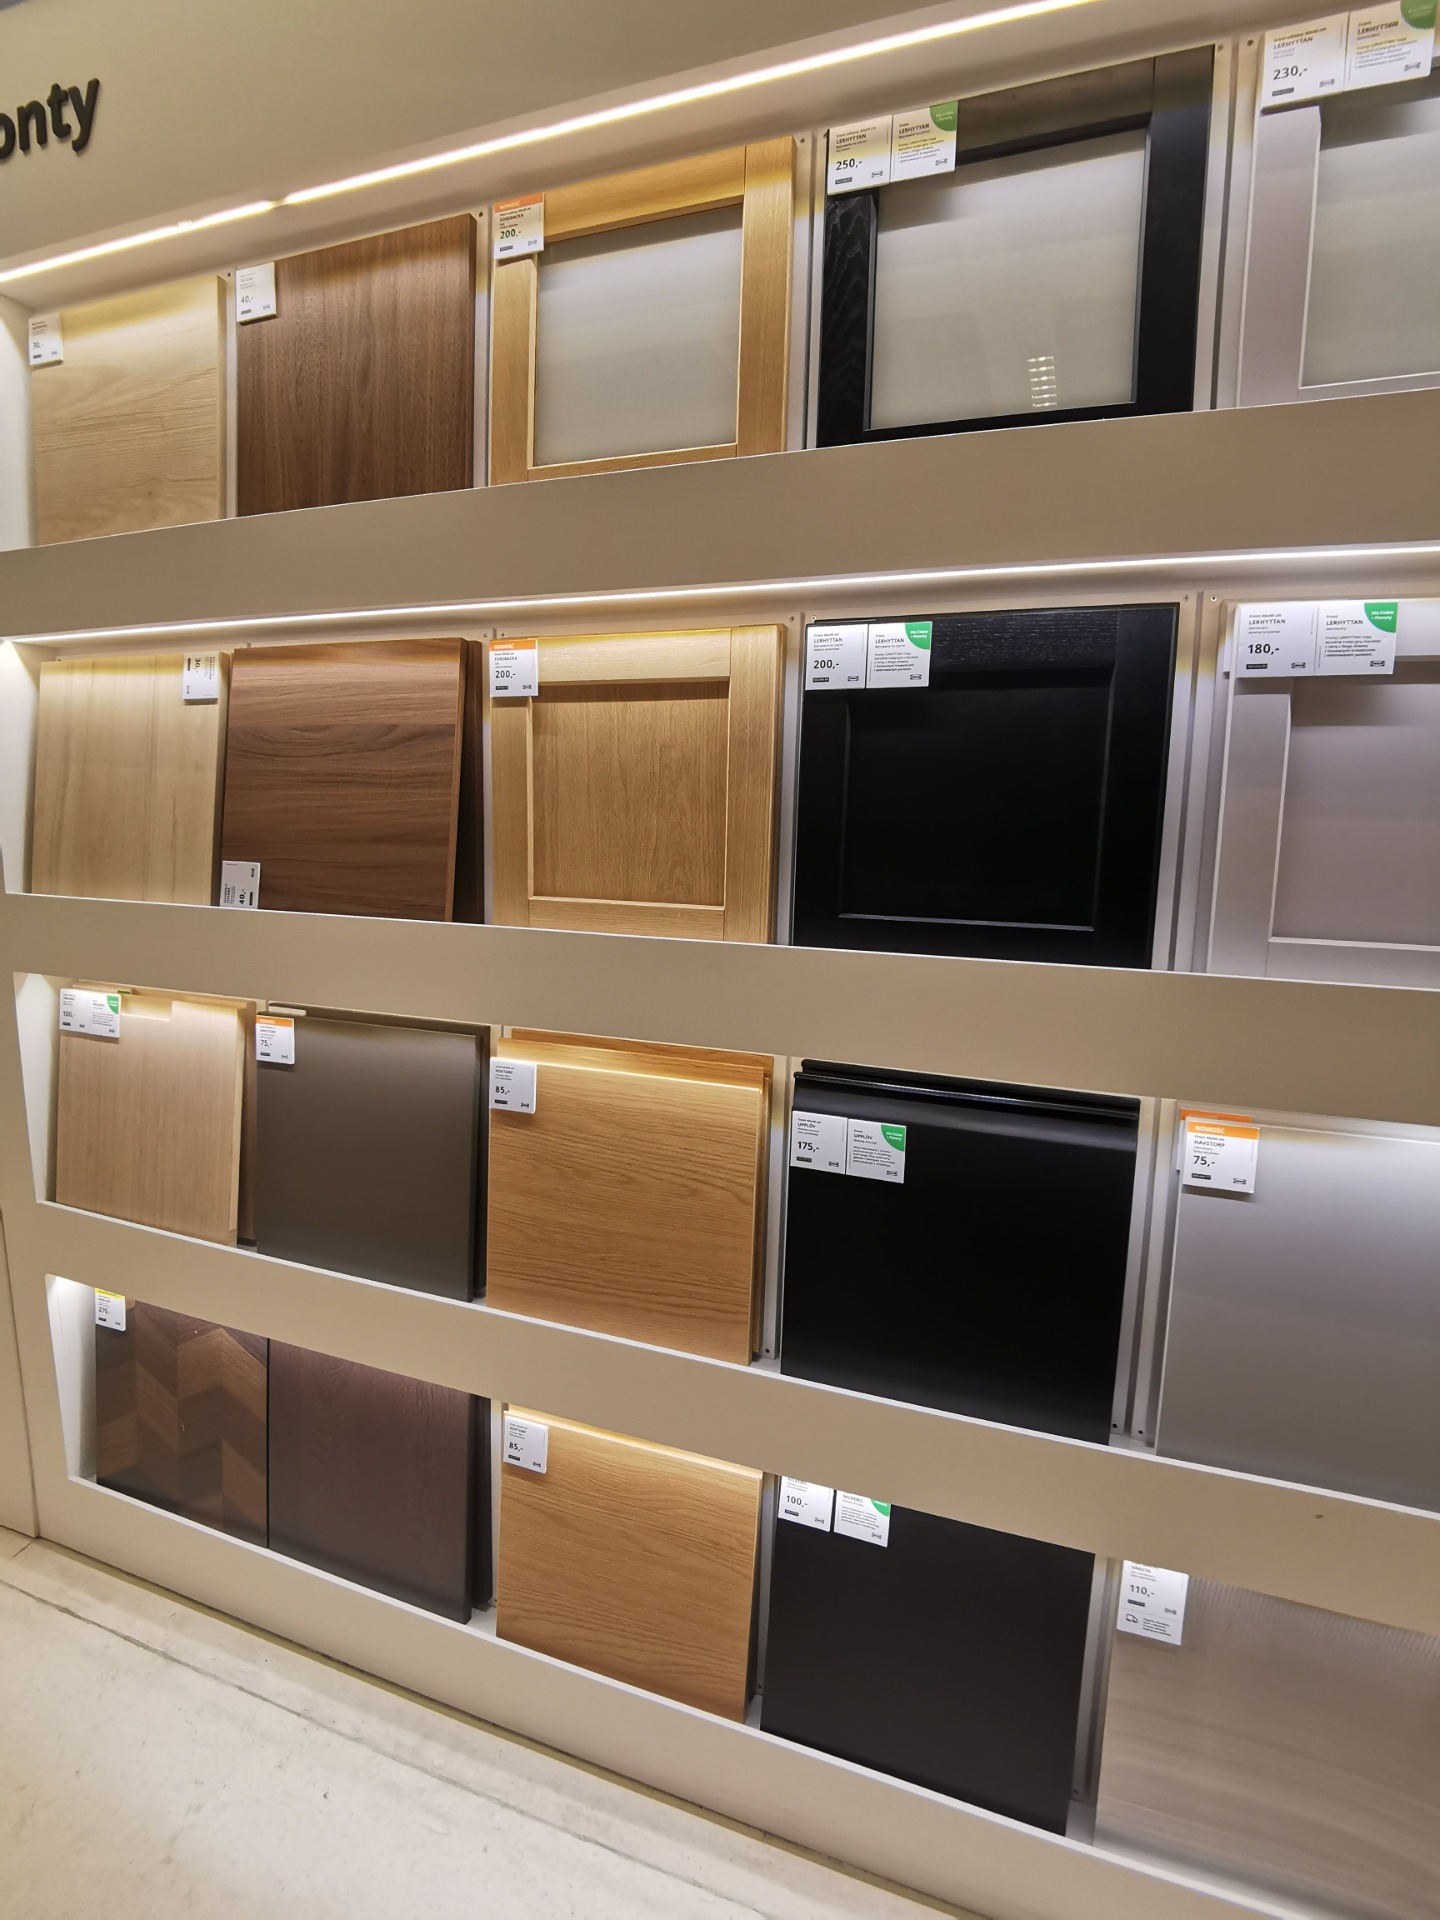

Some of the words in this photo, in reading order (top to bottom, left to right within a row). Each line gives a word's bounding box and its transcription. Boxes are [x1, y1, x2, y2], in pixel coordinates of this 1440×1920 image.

[1273, 65, 1308, 81] 230,-
[836, 158, 863, 171] 250,-
[500, 228, 522, 240] 200,-
[1248, 643, 1280, 656] 180,-
[813, 659, 840, 670] 200,-
[495, 670, 516, 679] 200,-
[260, 1039, 273, 1048] 75,-
[495, 1085, 511, 1096] 85,-
[797, 1141, 820, 1153] 175,-
[1194, 1140, 1226, 1148] HAVSTORP
[1193, 1155, 1216, 1168] 75,-
[509, 1441, 524, 1452] 85,-
[786, 1495, 808, 1508] 100,-
[1130, 1584, 1155, 1598] 110,-
